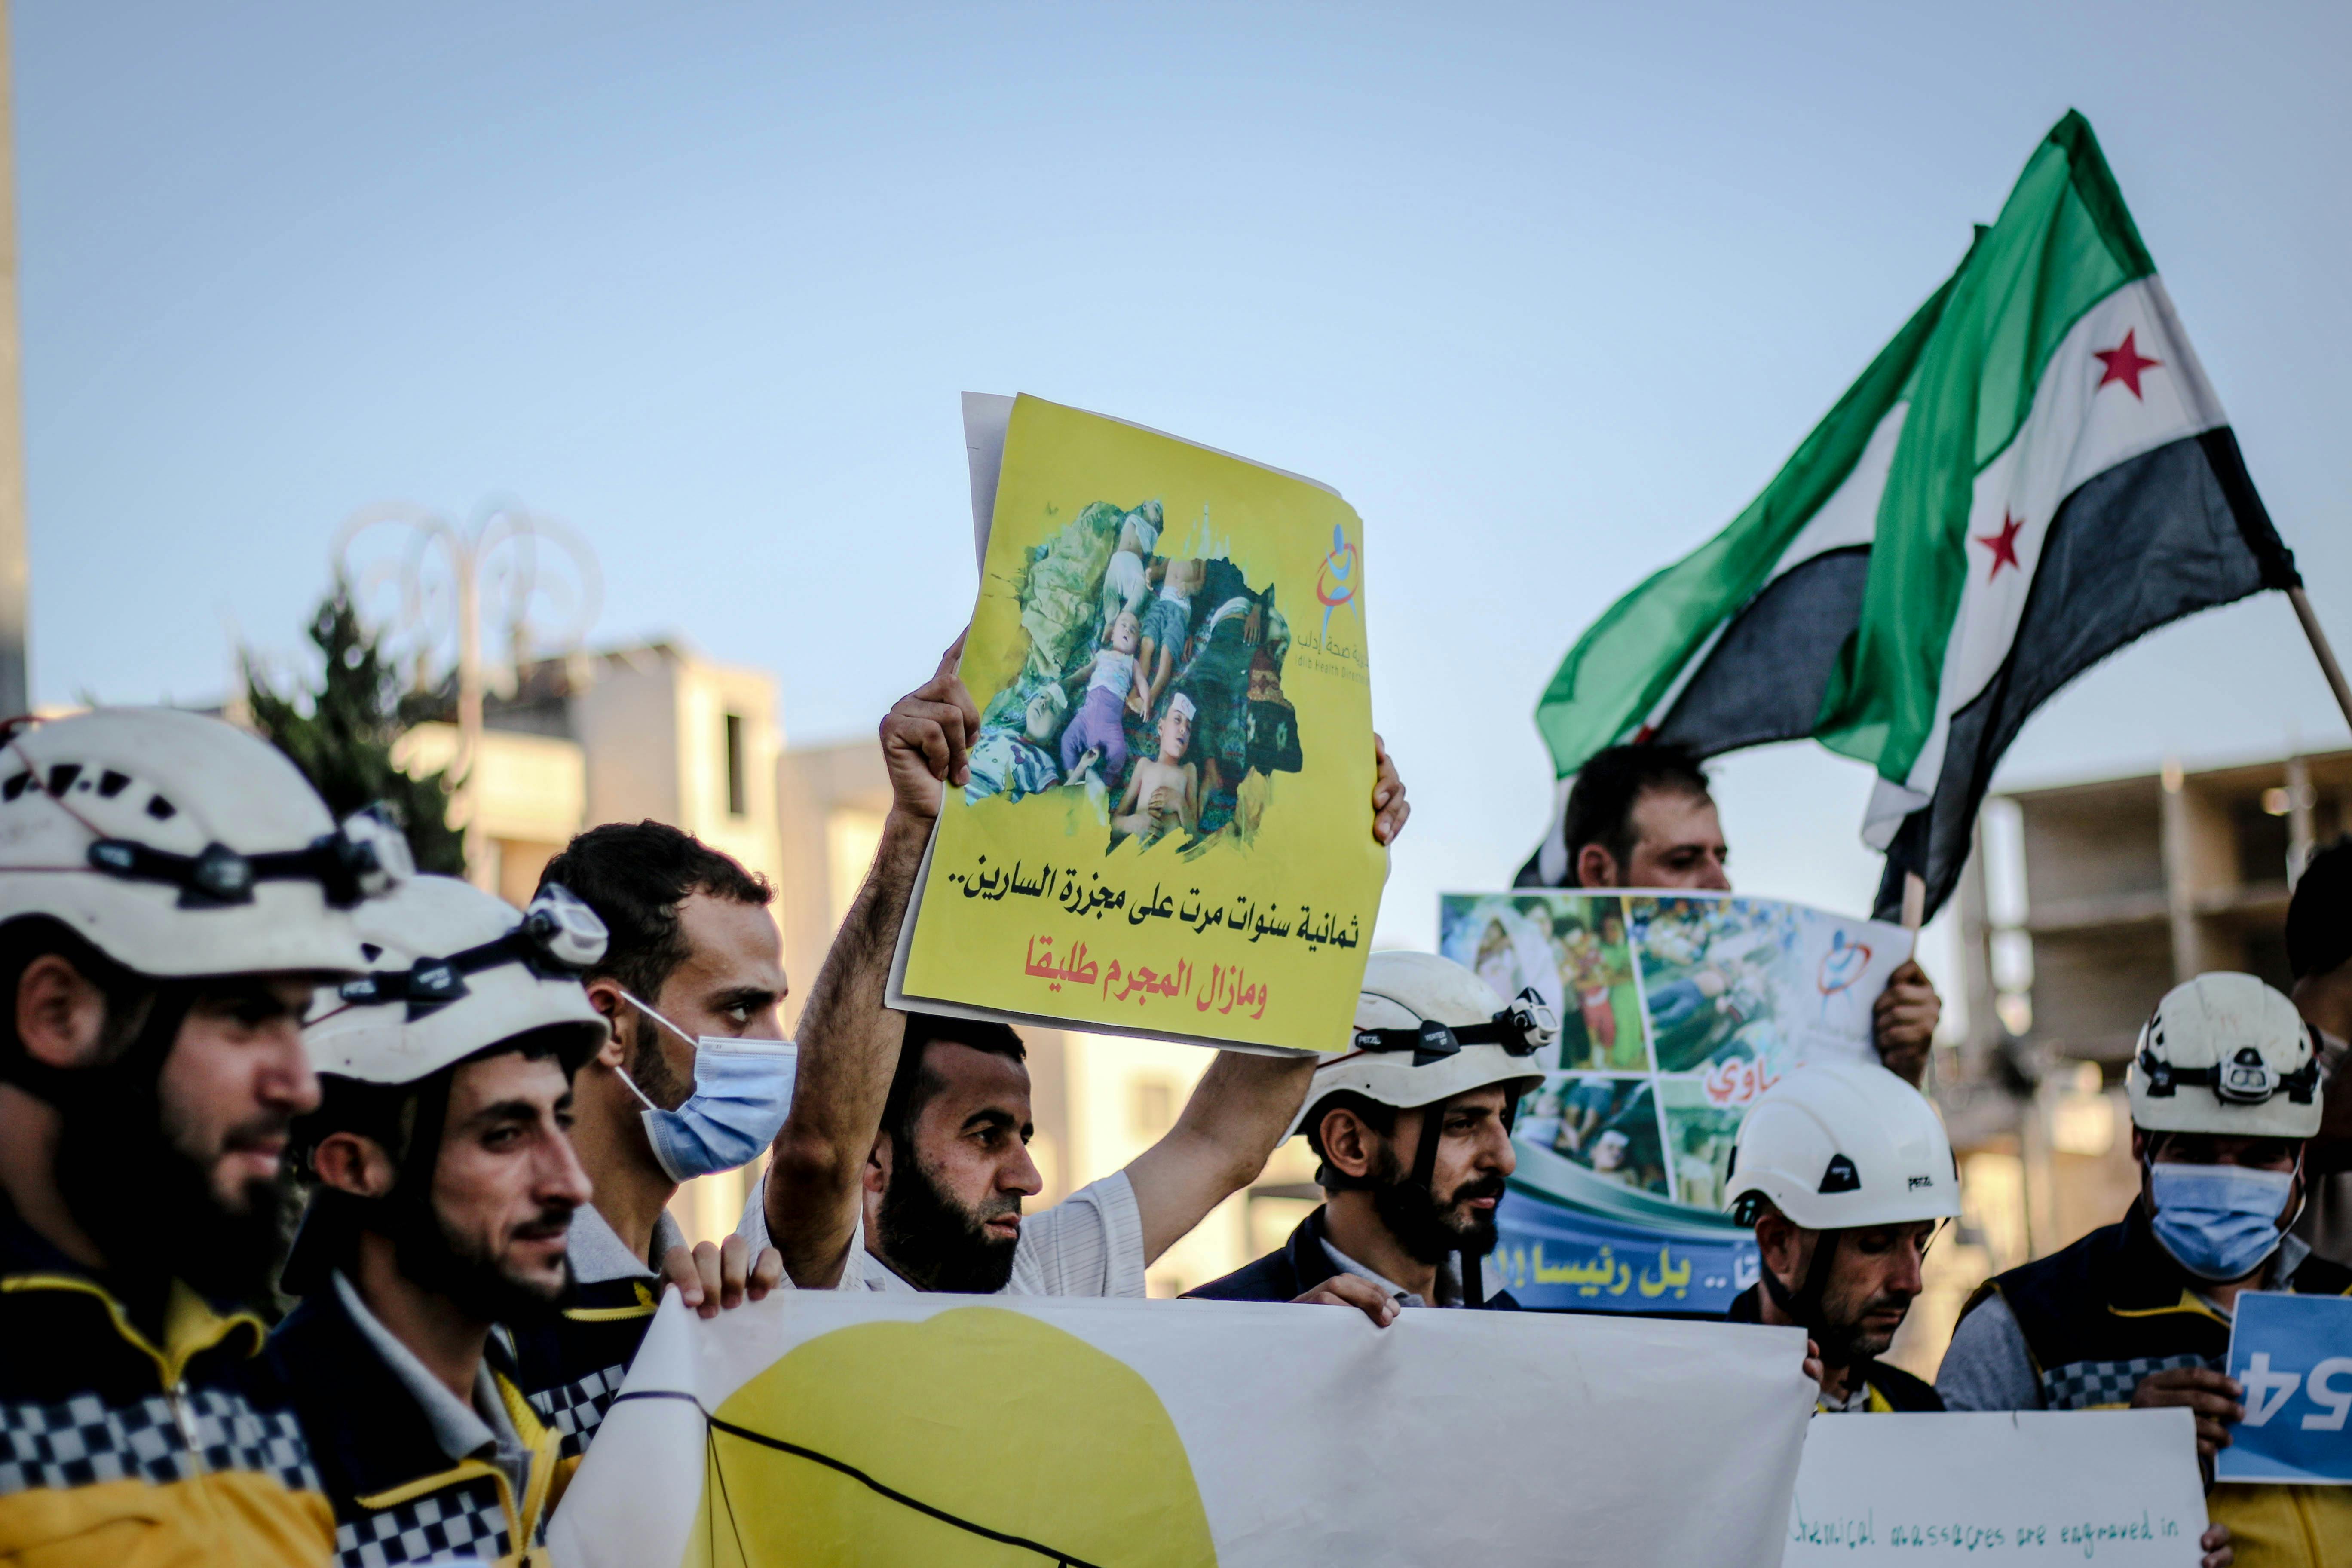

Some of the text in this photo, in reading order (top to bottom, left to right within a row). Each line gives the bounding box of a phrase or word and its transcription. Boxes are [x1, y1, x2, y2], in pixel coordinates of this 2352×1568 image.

[1298, 629, 1322, 655] إدلب
[1326, 636, 1350, 658] صحة
[1315, 659, 1338, 677] Health
[1059, 868, 1126, 920] مجزرة
[1128, 882, 1173, 925] على
[1179, 888, 1223, 934] مرت
[1228, 896, 1291, 943] سنوات
[1296, 906, 1358, 952] ثمانية
[1025, 934, 1268, 1020] ومازال المجرم طليقا
[1640, 1246, 1690, 1298] بل
[2016, 1524, 2046, 1547] are
[2061, 1507, 2153, 1559] engraved
[2161, 1518, 2179, 1537] in
